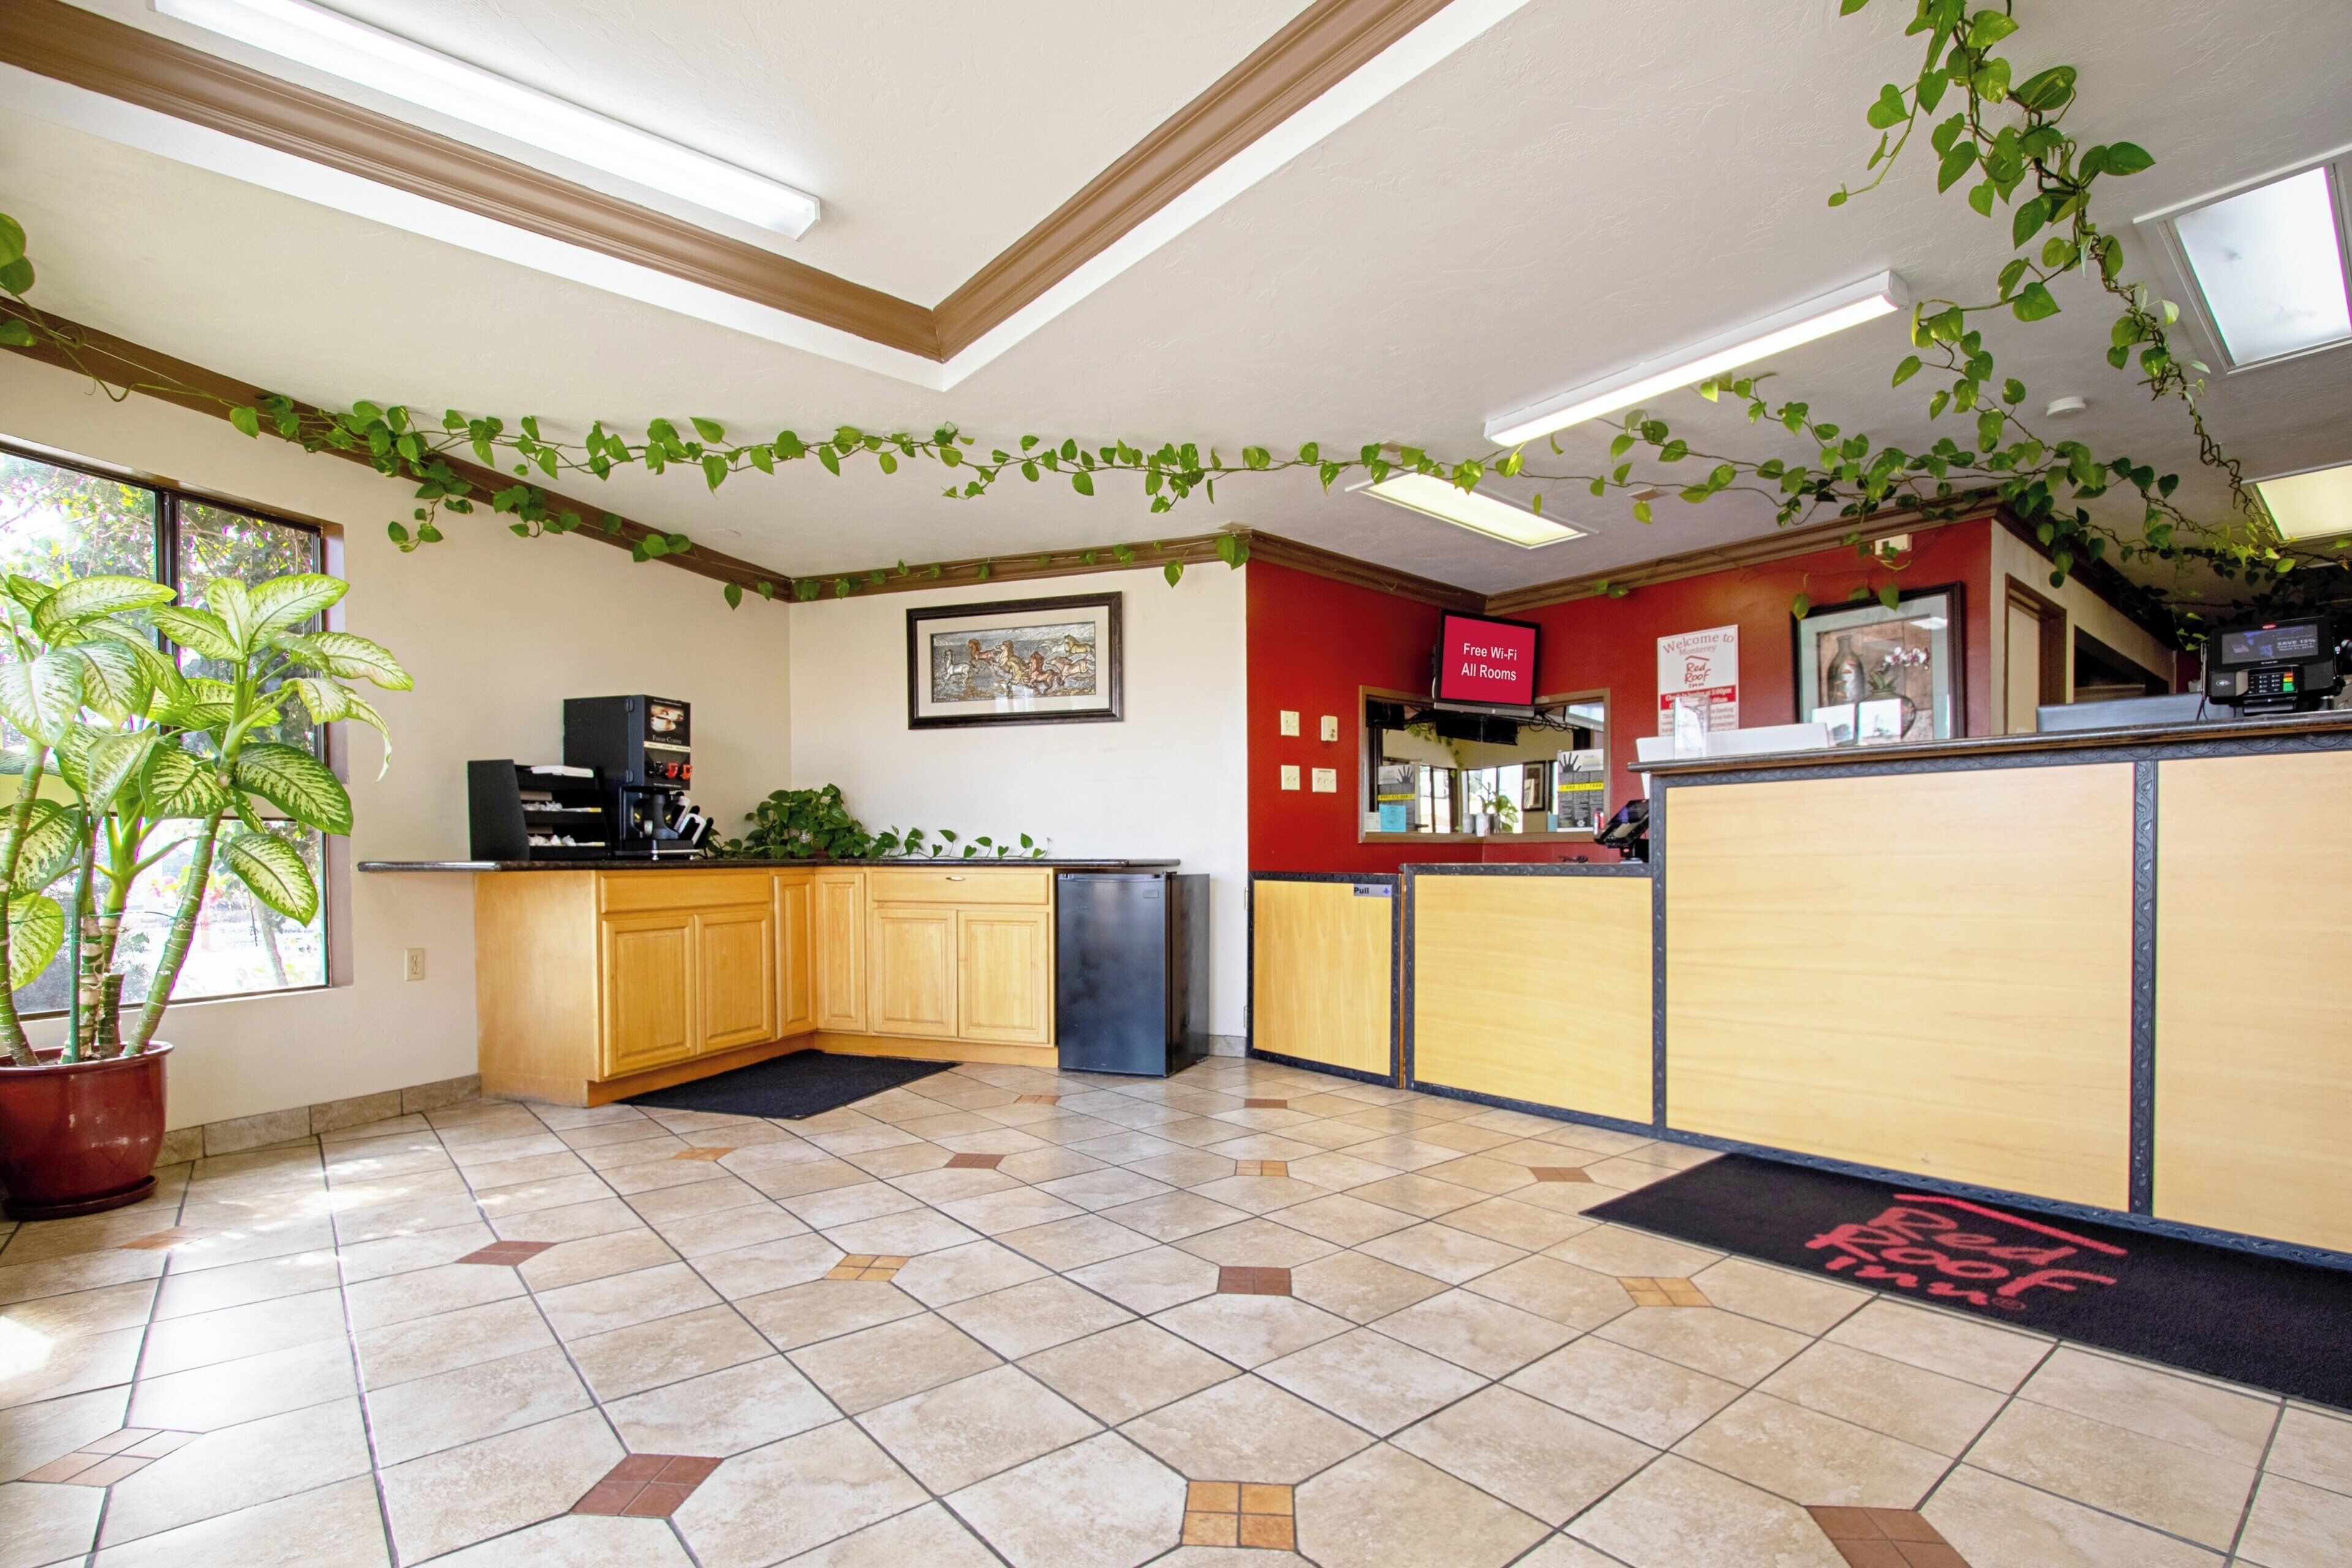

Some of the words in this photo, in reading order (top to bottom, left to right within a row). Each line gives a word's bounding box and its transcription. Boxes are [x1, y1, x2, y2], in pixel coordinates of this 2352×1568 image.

[1463, 643, 1488, 657] Free
[1491, 646, 1517, 661] Wi-Fi
[1663, 635, 1719, 654] Welcome
[1722, 633, 1734, 643] to
[1679, 645, 1717, 656] Monterey
[1461, 663, 1477, 677] All
[1480, 665, 1517, 681] Rooms
[1684, 668, 1712, 684] Roof
[1686, 662, 1706, 673] Red
[1867, 1207, 2078, 1265] Red
[1804, 1224, 2117, 1297] Roof
